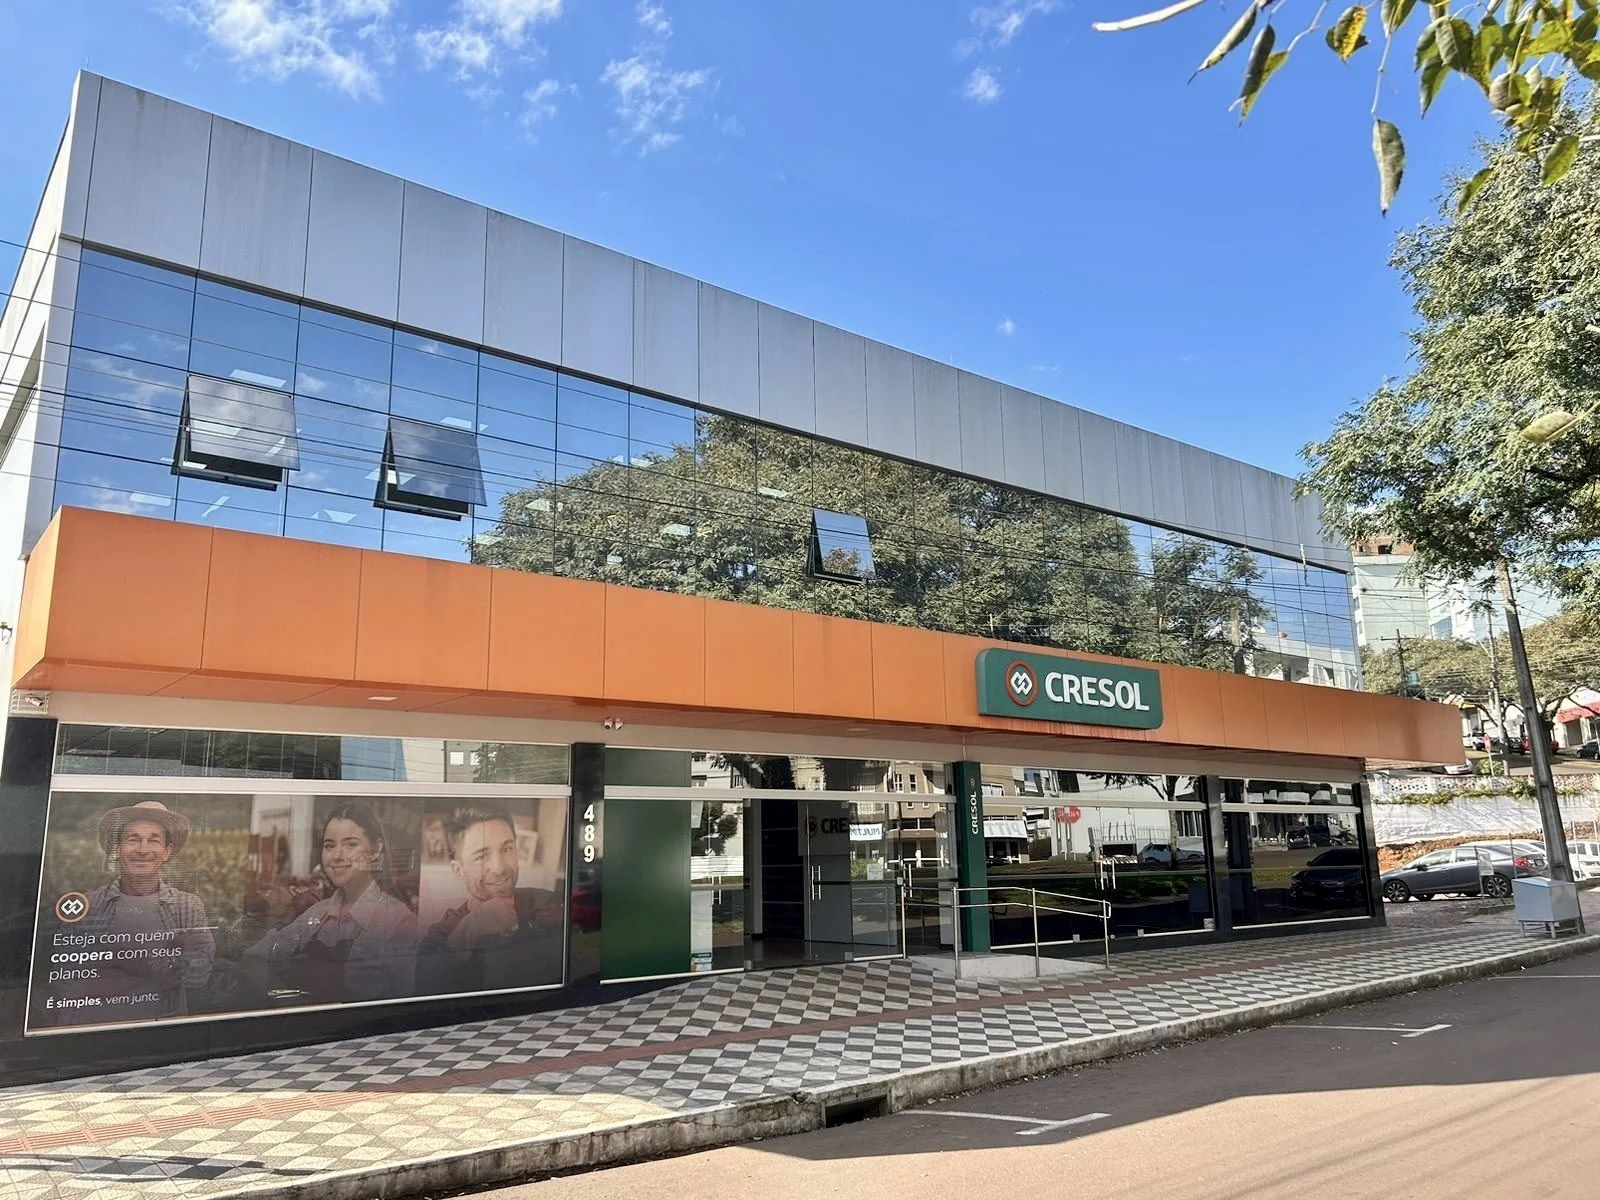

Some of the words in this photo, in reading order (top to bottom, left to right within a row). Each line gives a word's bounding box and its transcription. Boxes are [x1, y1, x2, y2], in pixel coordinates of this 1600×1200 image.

[1045, 671, 1149, 711] CRESOL
[970, 791, 979, 834] CRESOL
[583, 804, 595, 863] 489
[53, 932, 96, 948] Esteja
[99, 933, 131, 944] com
[134, 931, 175, 945] quem
[50, 950, 113, 964] coopera
[117, 949, 148, 960] com
[152, 947, 182, 958] seus
[49, 967, 100, 983] planos.
[46, 997, 54, 1009] É
[56, 996, 103, 1009] simples,
[105, 997, 130, 1005] vem
